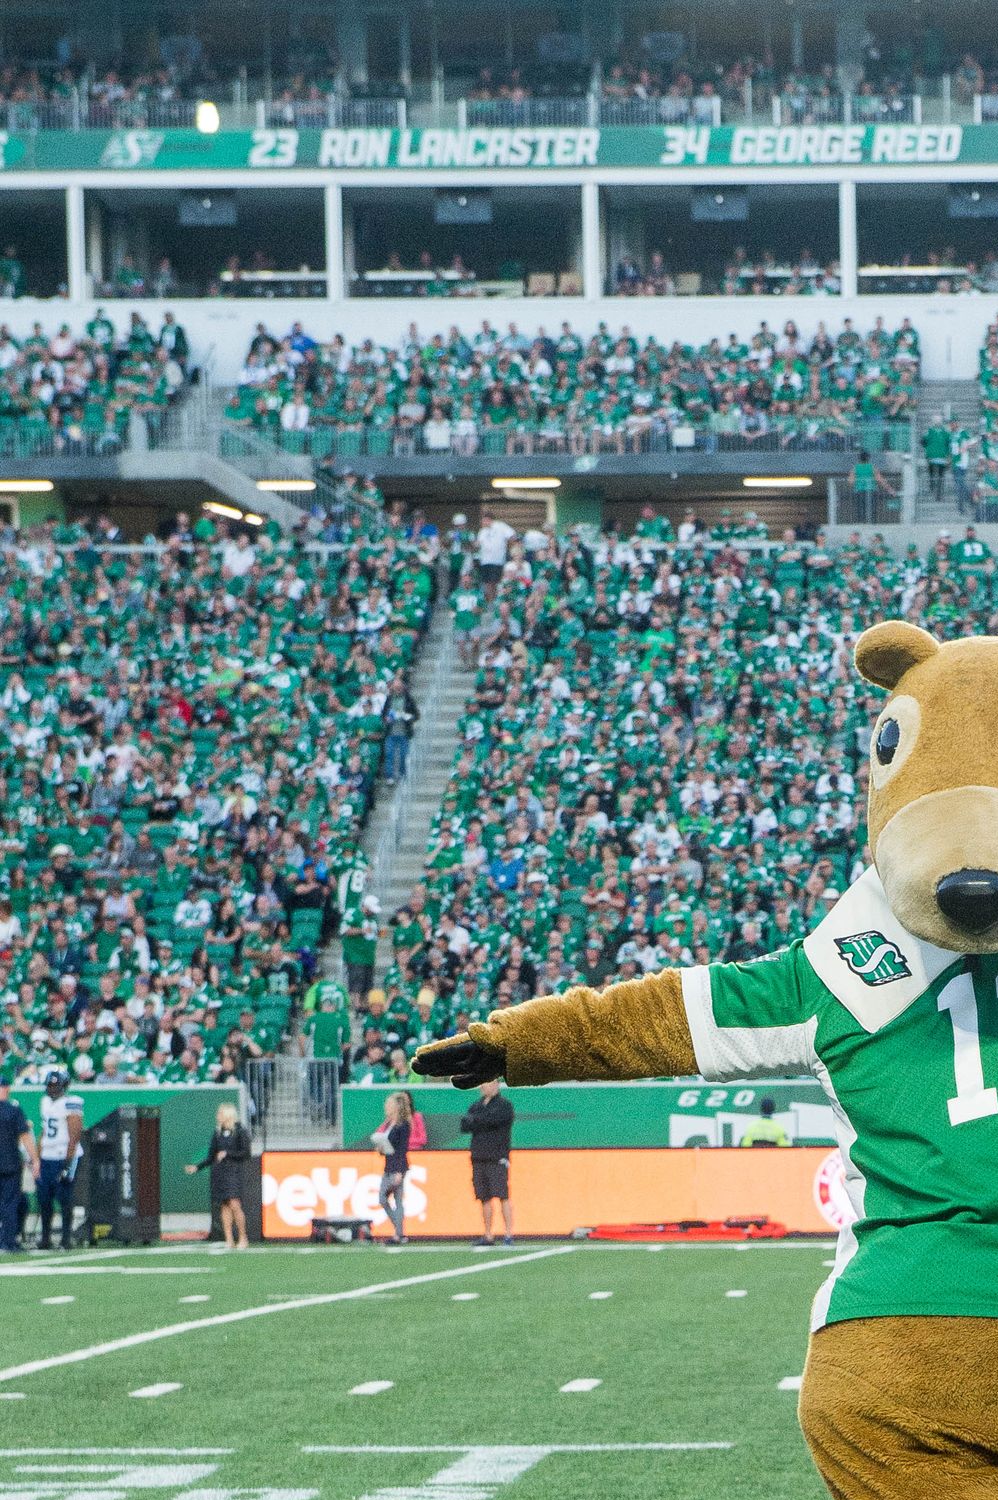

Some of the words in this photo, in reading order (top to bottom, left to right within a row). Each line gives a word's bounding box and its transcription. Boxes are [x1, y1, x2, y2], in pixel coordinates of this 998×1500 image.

[248, 129, 298, 167] 23
[319, 129, 395, 167] RON
[397, 127, 600, 167] LANCASTER
[660, 127, 711, 164] 34
[730, 127, 866, 164] GEORGE
[871, 126, 963, 164] REED
